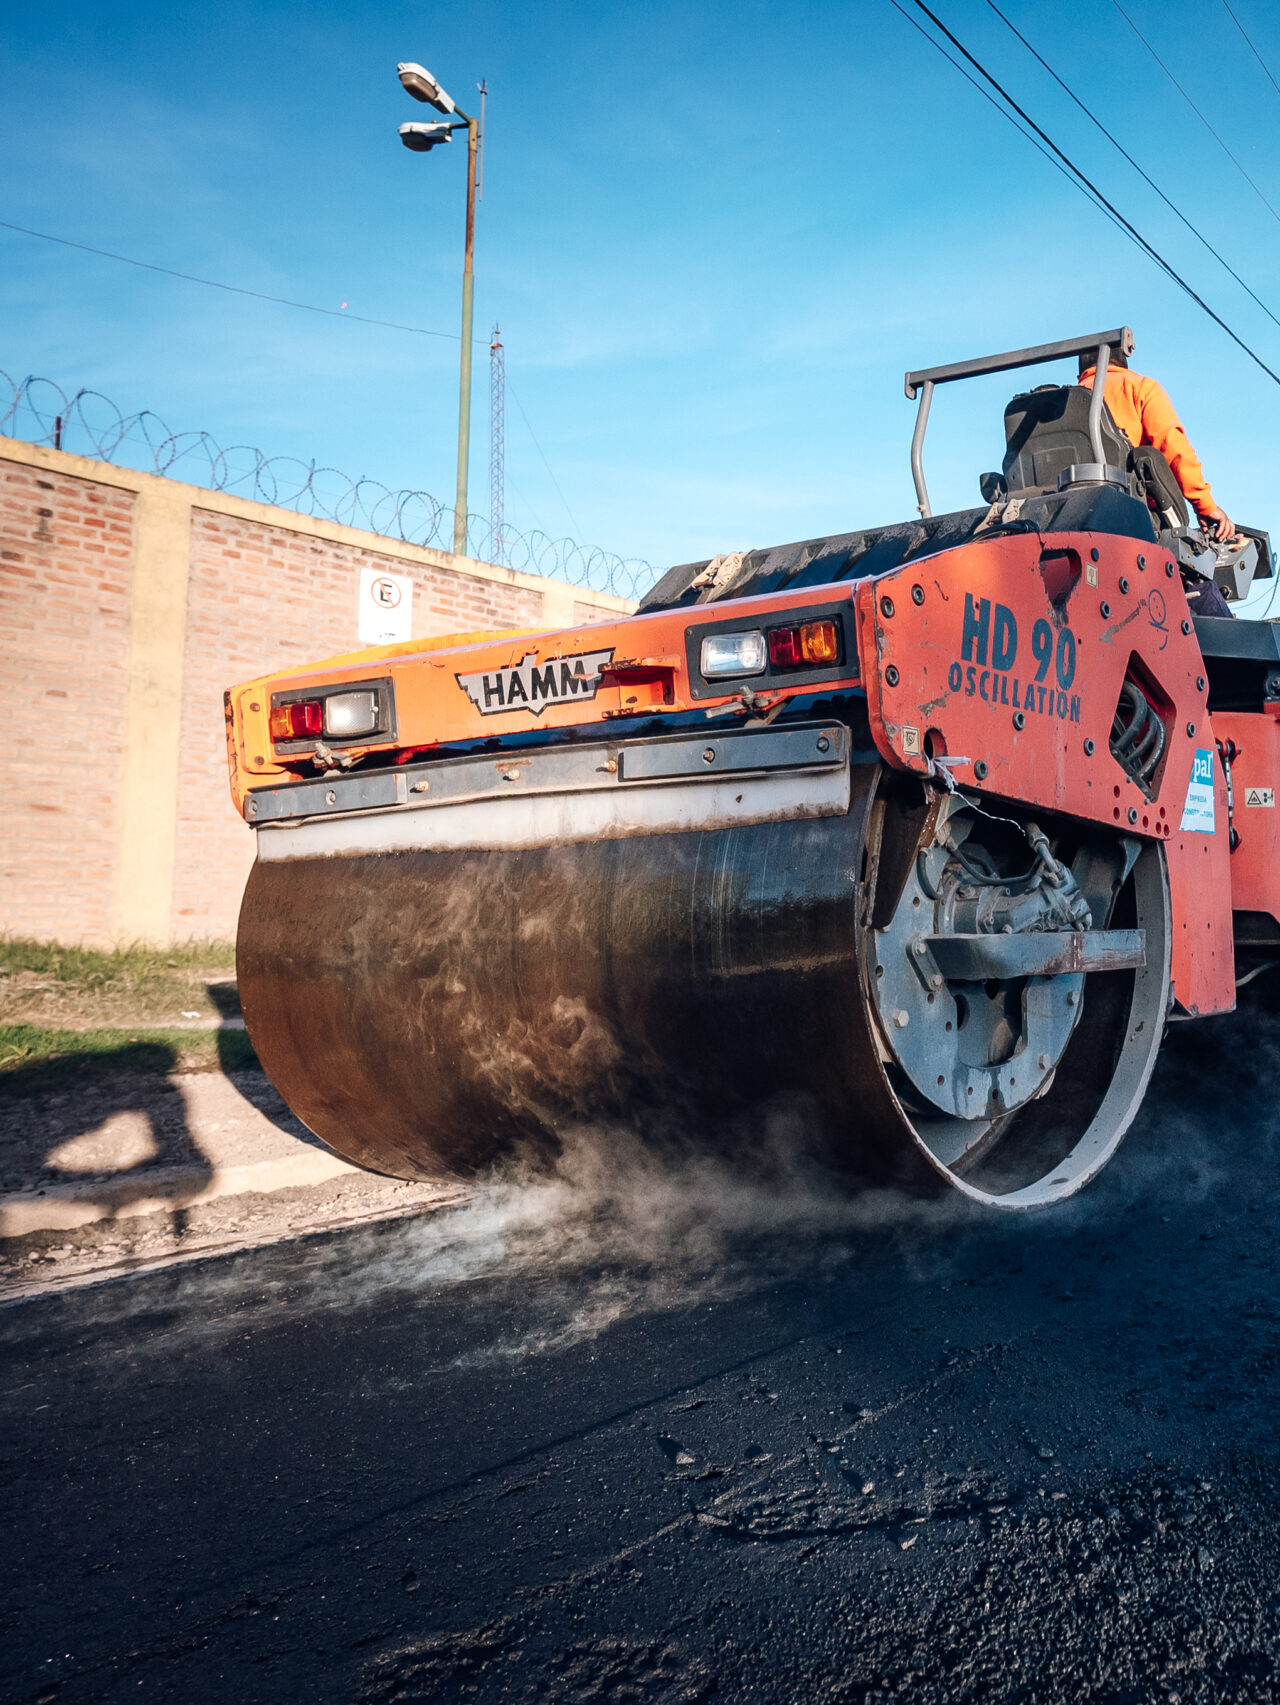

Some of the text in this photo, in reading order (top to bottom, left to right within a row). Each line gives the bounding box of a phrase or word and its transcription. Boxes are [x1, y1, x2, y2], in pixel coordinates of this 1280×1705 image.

[961, 592, 1076, 691] HD 90
[482, 660, 589, 708] HAMM
[948, 661, 1081, 723] OSCILLATION
